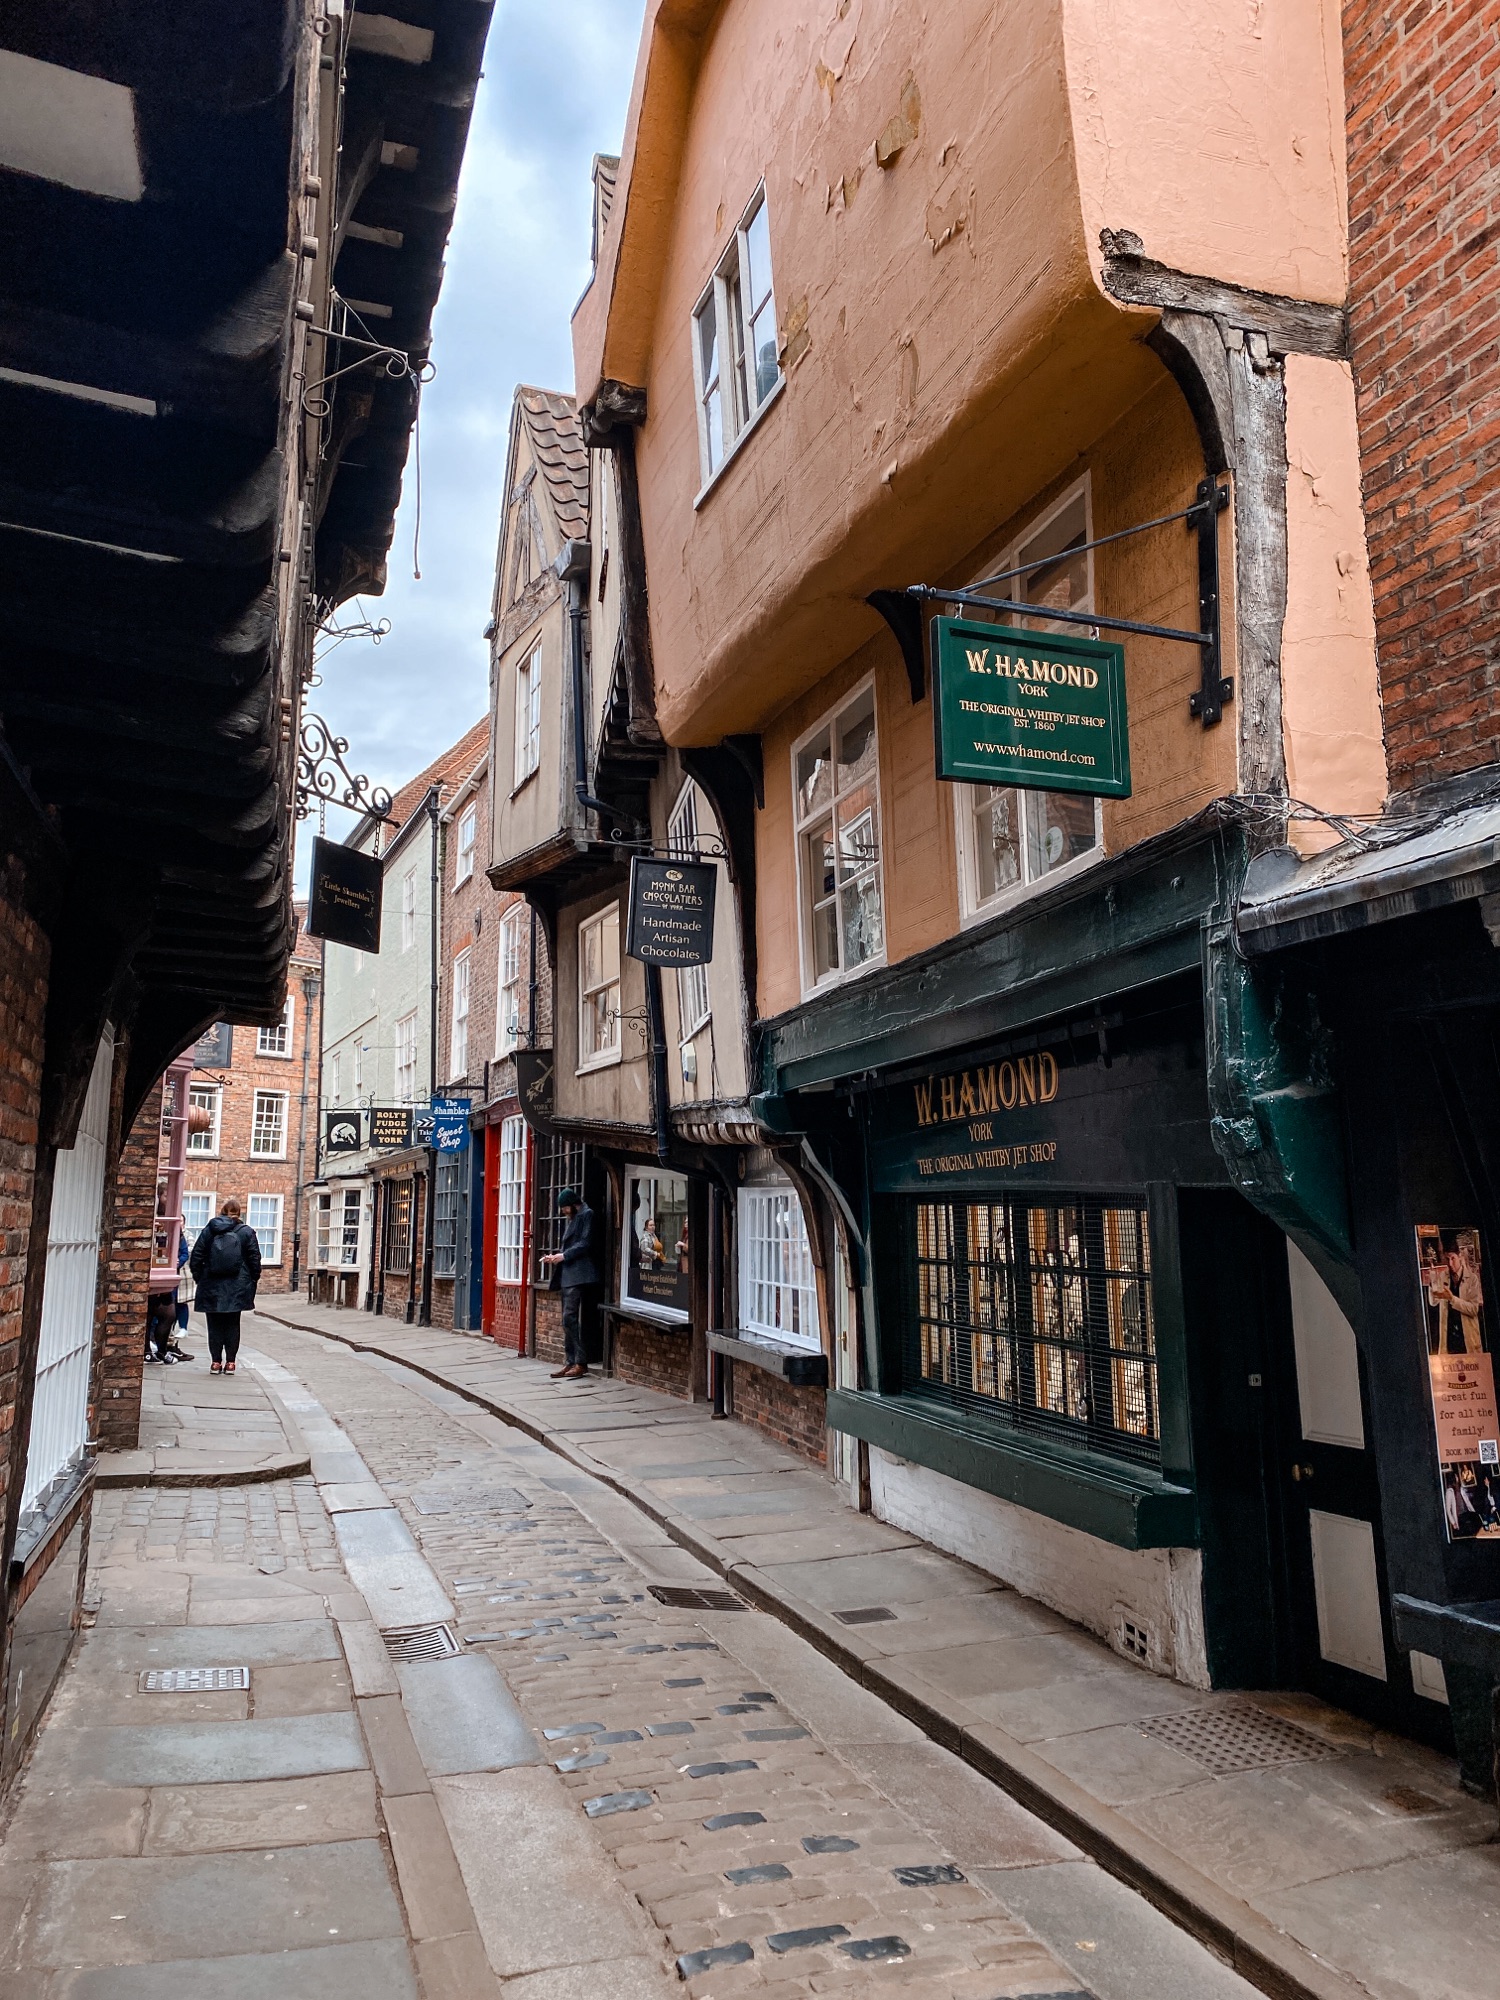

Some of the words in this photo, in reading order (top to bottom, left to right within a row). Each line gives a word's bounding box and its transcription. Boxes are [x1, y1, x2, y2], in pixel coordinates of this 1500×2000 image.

[965, 648, 992, 674] W.
[995, 654, 1099, 689] HAMOND
[1017, 683, 1049, 697] YORK
[959, 700, 979, 711] THE
[980, 703, 1026, 718] ORIGINAL
[1027, 709, 1065, 722] WHITBY
[1064, 714, 1080, 725] JET
[1081, 716, 1106, 728] SHOP
[1013, 718, 1031, 728] EST.
[1034, 720, 1056, 731] 1860
[973, 742, 1096, 766] www.whamond.com
[324, 880, 341, 893] Little
[342, 886, 370, 903] Shambles
[651, 881, 676, 892] MONK
[678, 883, 696, 894] BAR
[333, 894, 360, 910] Jewellers
[642, 891, 703, 906] CHOCOLATIERS
[642, 916, 702, 932] Handmade
[652, 932, 690, 945] Artisan
[640, 944, 700, 960] Chocolates
[913, 1073, 939, 1127] W.
[940, 1051, 1059, 1122] HAMOND
[444, 1099, 458, 1107] The
[376, 1111, 407, 1119] ROLY'S
[433, 1106, 470, 1115] Shambles
[373, 1128, 409, 1136] PANTRY
[436, 1124, 464, 1139] Sweet
[968, 1121, 994, 1142] YORK
[378, 1136, 404, 1144] YORK
[440, 1136, 461, 1149] Shop
[918, 1158, 934, 1175] THE
[934, 1153, 975, 1173] ORIGINAL
[975, 1148, 1011, 1169] WHITBY
[1013, 1145, 1028, 1170] JET
[1030, 1142, 1057, 1163] SHOP
[1441, 1391, 1467, 1402] Great
[1470, 1391, 1487, 1401] fun
[1440, 1410, 1455, 1420] for
[1458, 1408, 1474, 1418] all
[1477, 1408, 1493, 1417] the
[1452, 1426, 1485, 1437] family!
[1445, 1448, 1462, 1457] BOOK
